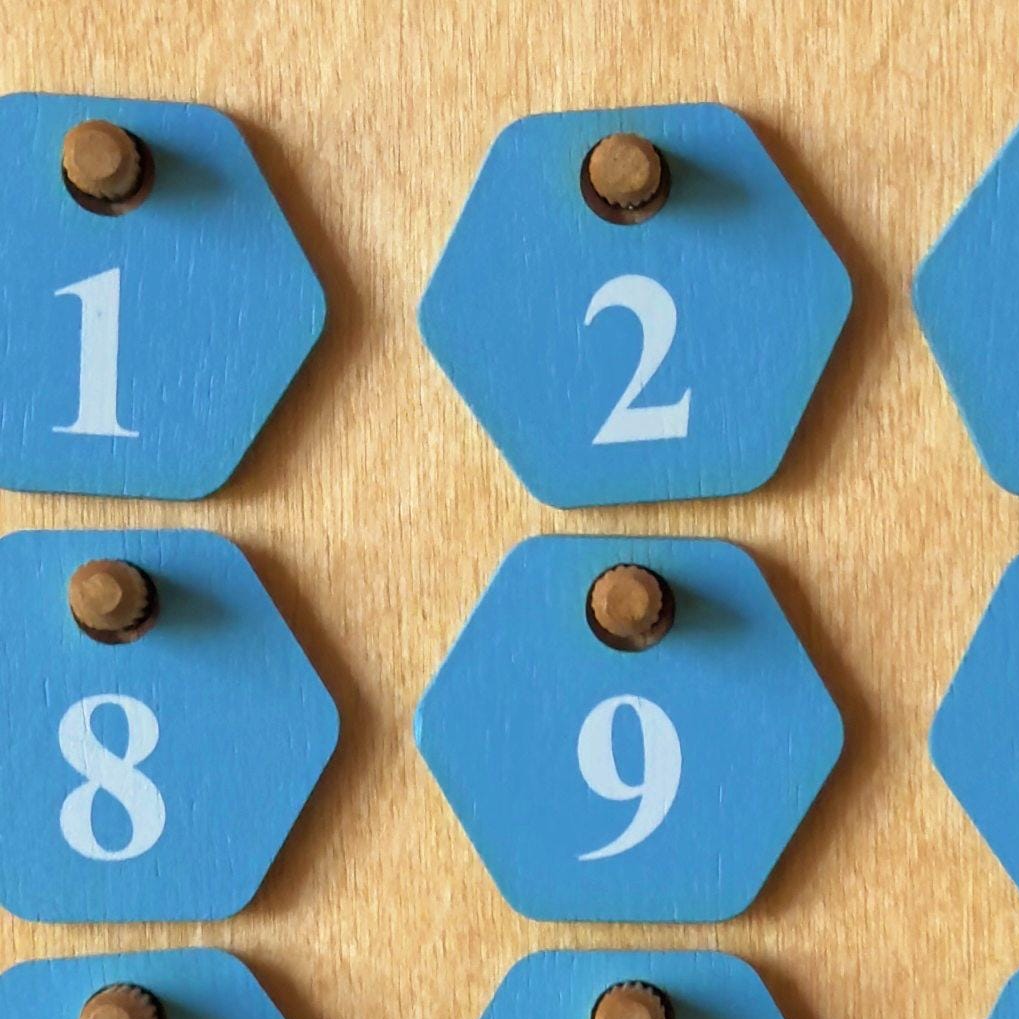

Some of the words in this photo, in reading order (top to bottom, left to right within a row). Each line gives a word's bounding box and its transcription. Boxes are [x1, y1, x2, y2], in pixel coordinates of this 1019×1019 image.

[53, 267, 137, 437] 1
[585, 274, 691, 445] 2
[59, 693, 166, 862] 8
[577, 694, 682, 861] 9
